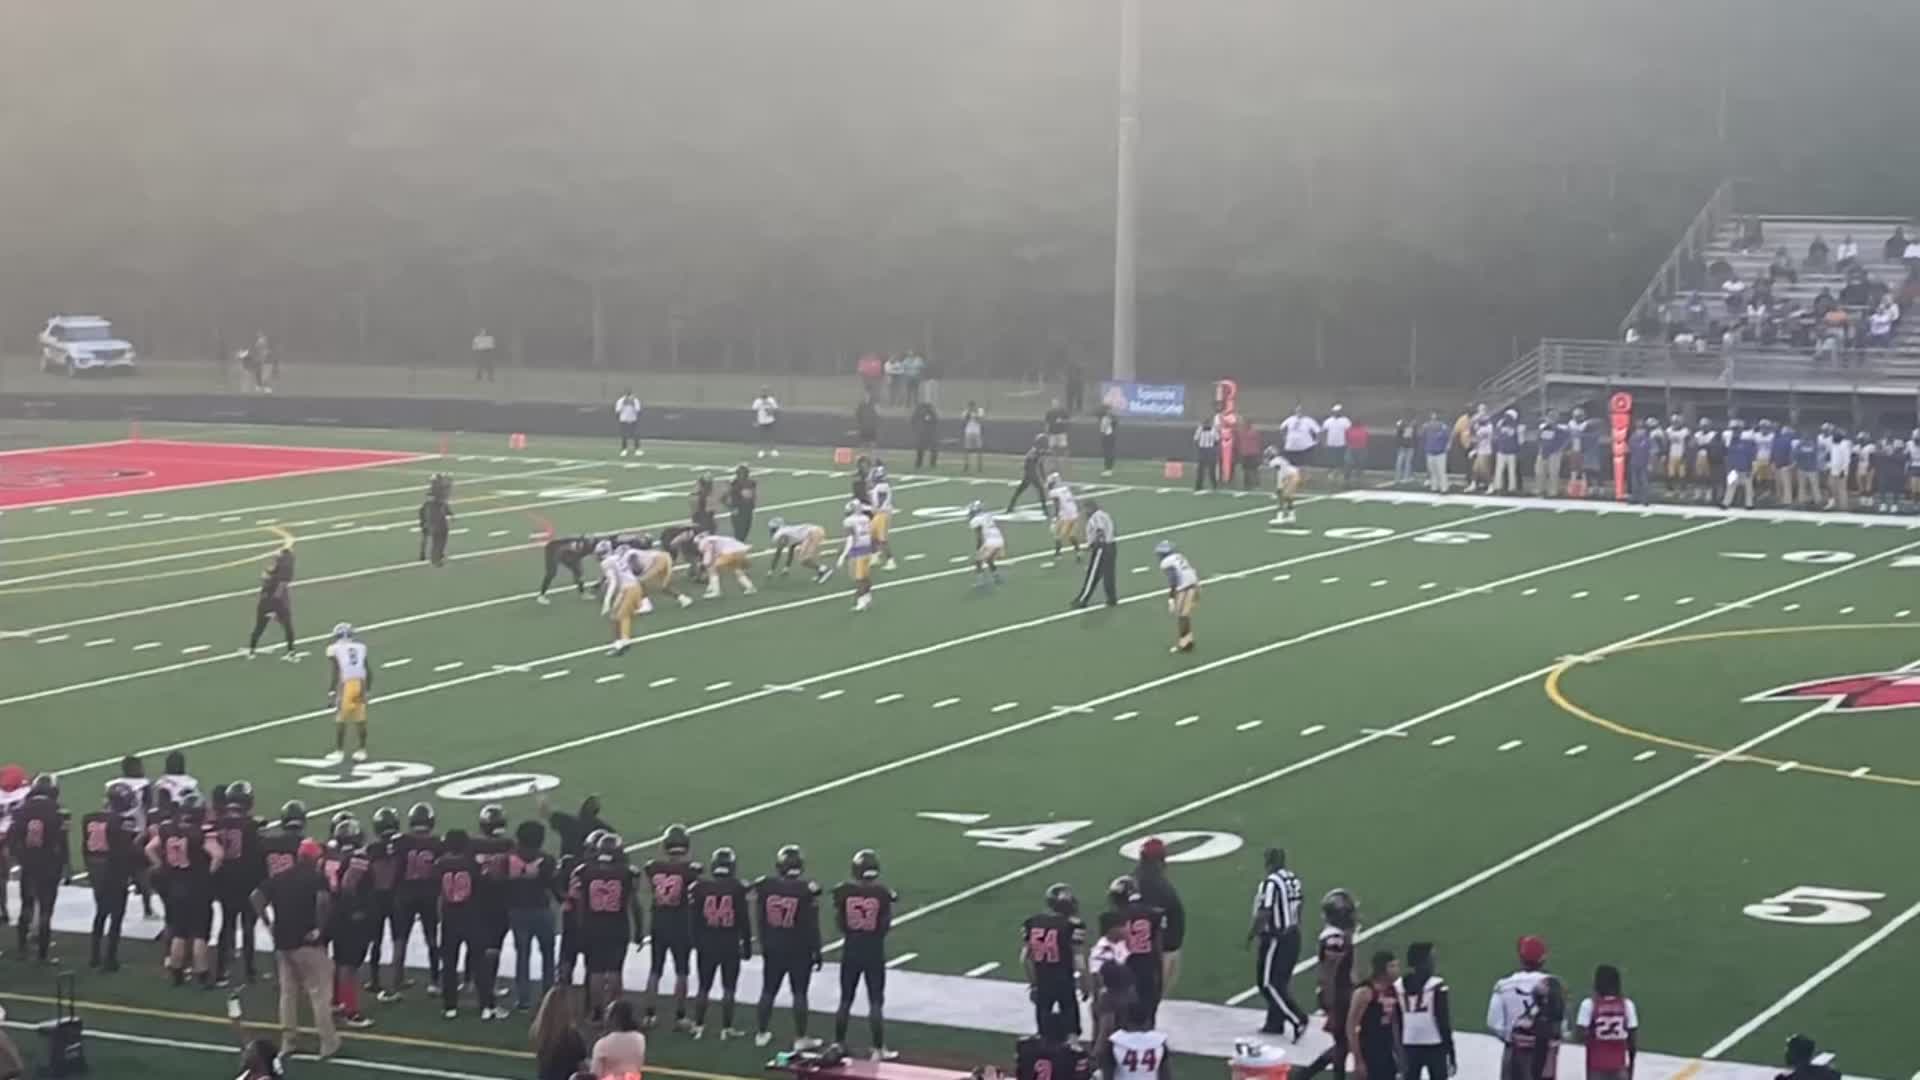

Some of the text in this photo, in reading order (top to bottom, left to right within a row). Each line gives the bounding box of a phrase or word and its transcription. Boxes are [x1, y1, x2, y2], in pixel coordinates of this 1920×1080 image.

[962, 819, 1244, 864] 40
[703, 895, 736, 927] 44
[1743, 885, 1888, 926] 5
[1029, 927, 1060, 962] 54
[1595, 1016, 1629, 1040] 23
[1122, 1048, 1158, 1072] 44
